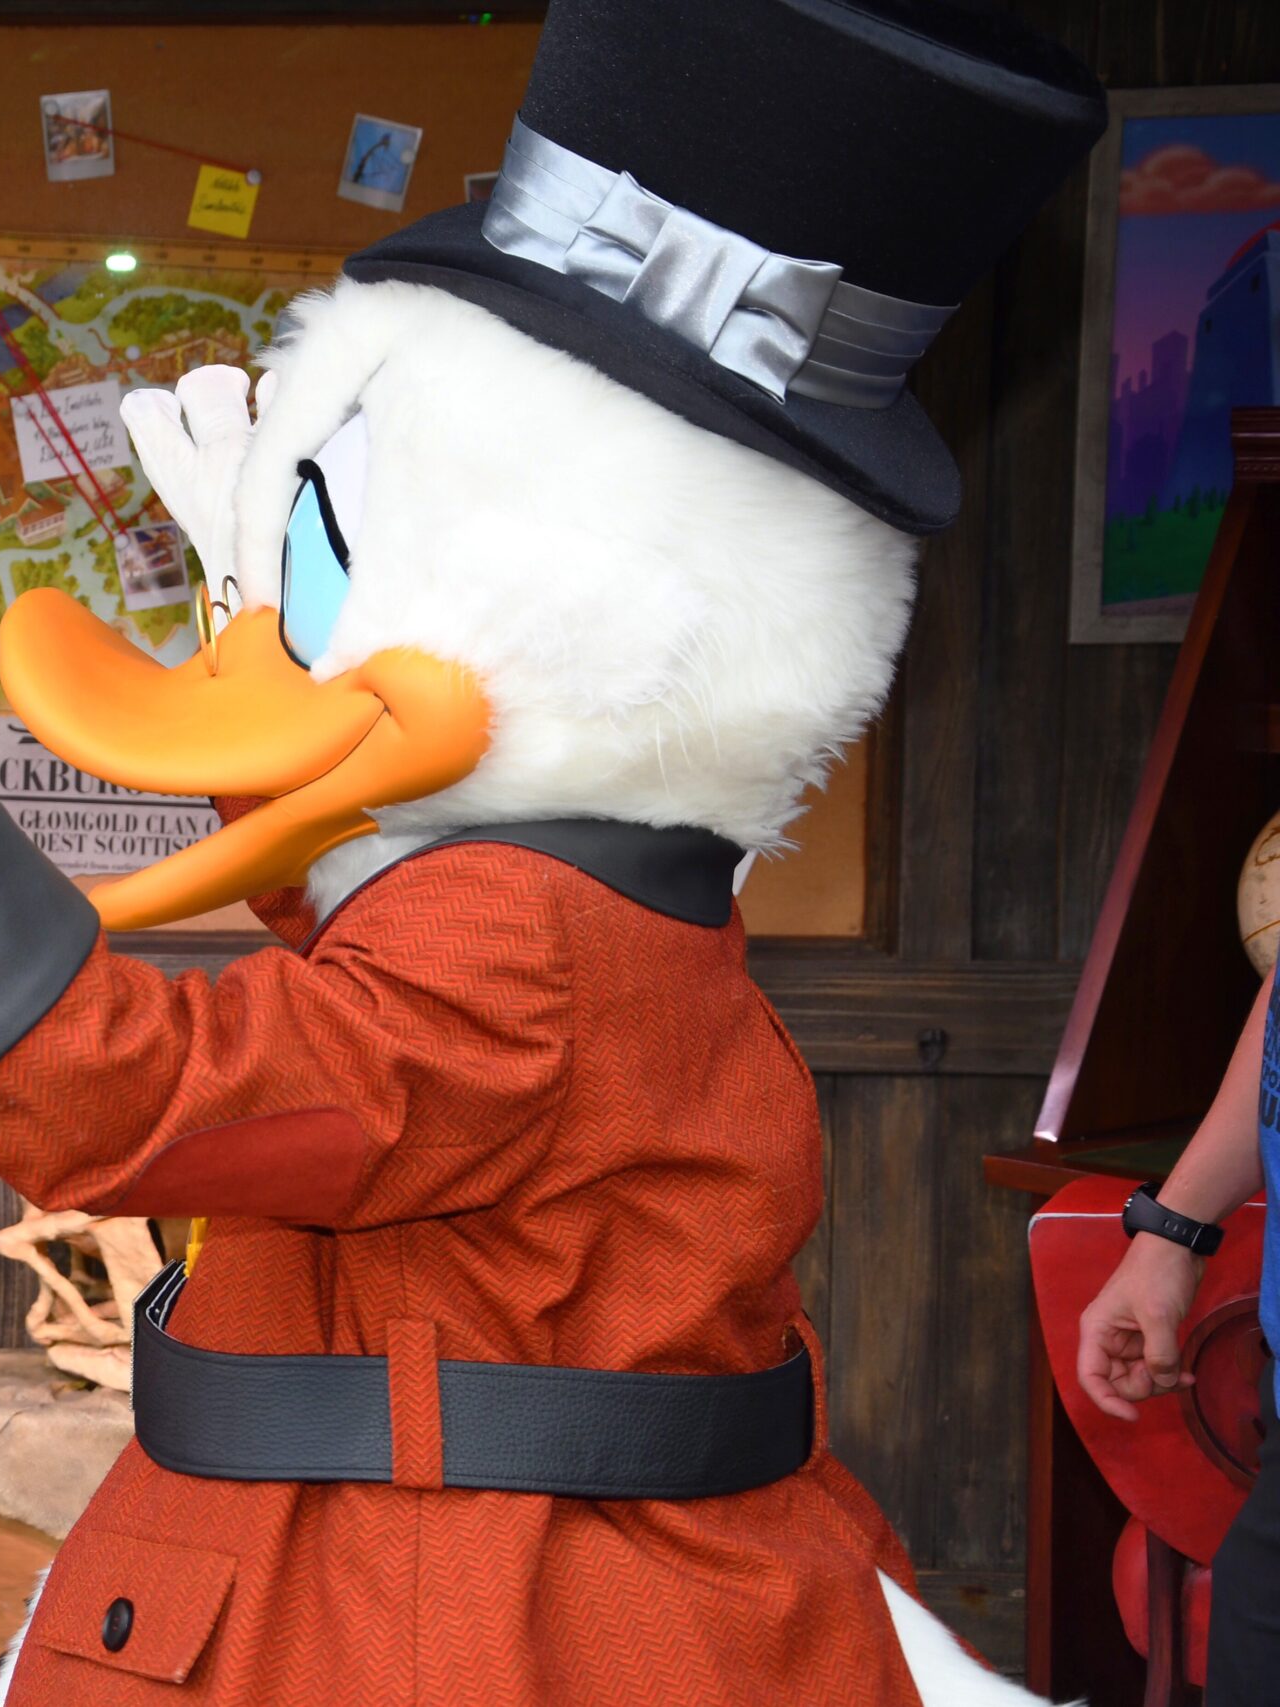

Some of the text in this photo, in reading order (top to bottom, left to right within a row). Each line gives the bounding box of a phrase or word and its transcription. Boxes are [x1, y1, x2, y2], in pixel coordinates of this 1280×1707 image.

[20, 809, 138, 833] GLOMGOLD
[146, 814, 198, 834] CLAN
[94, 833, 200, 856] SCOTTIS
